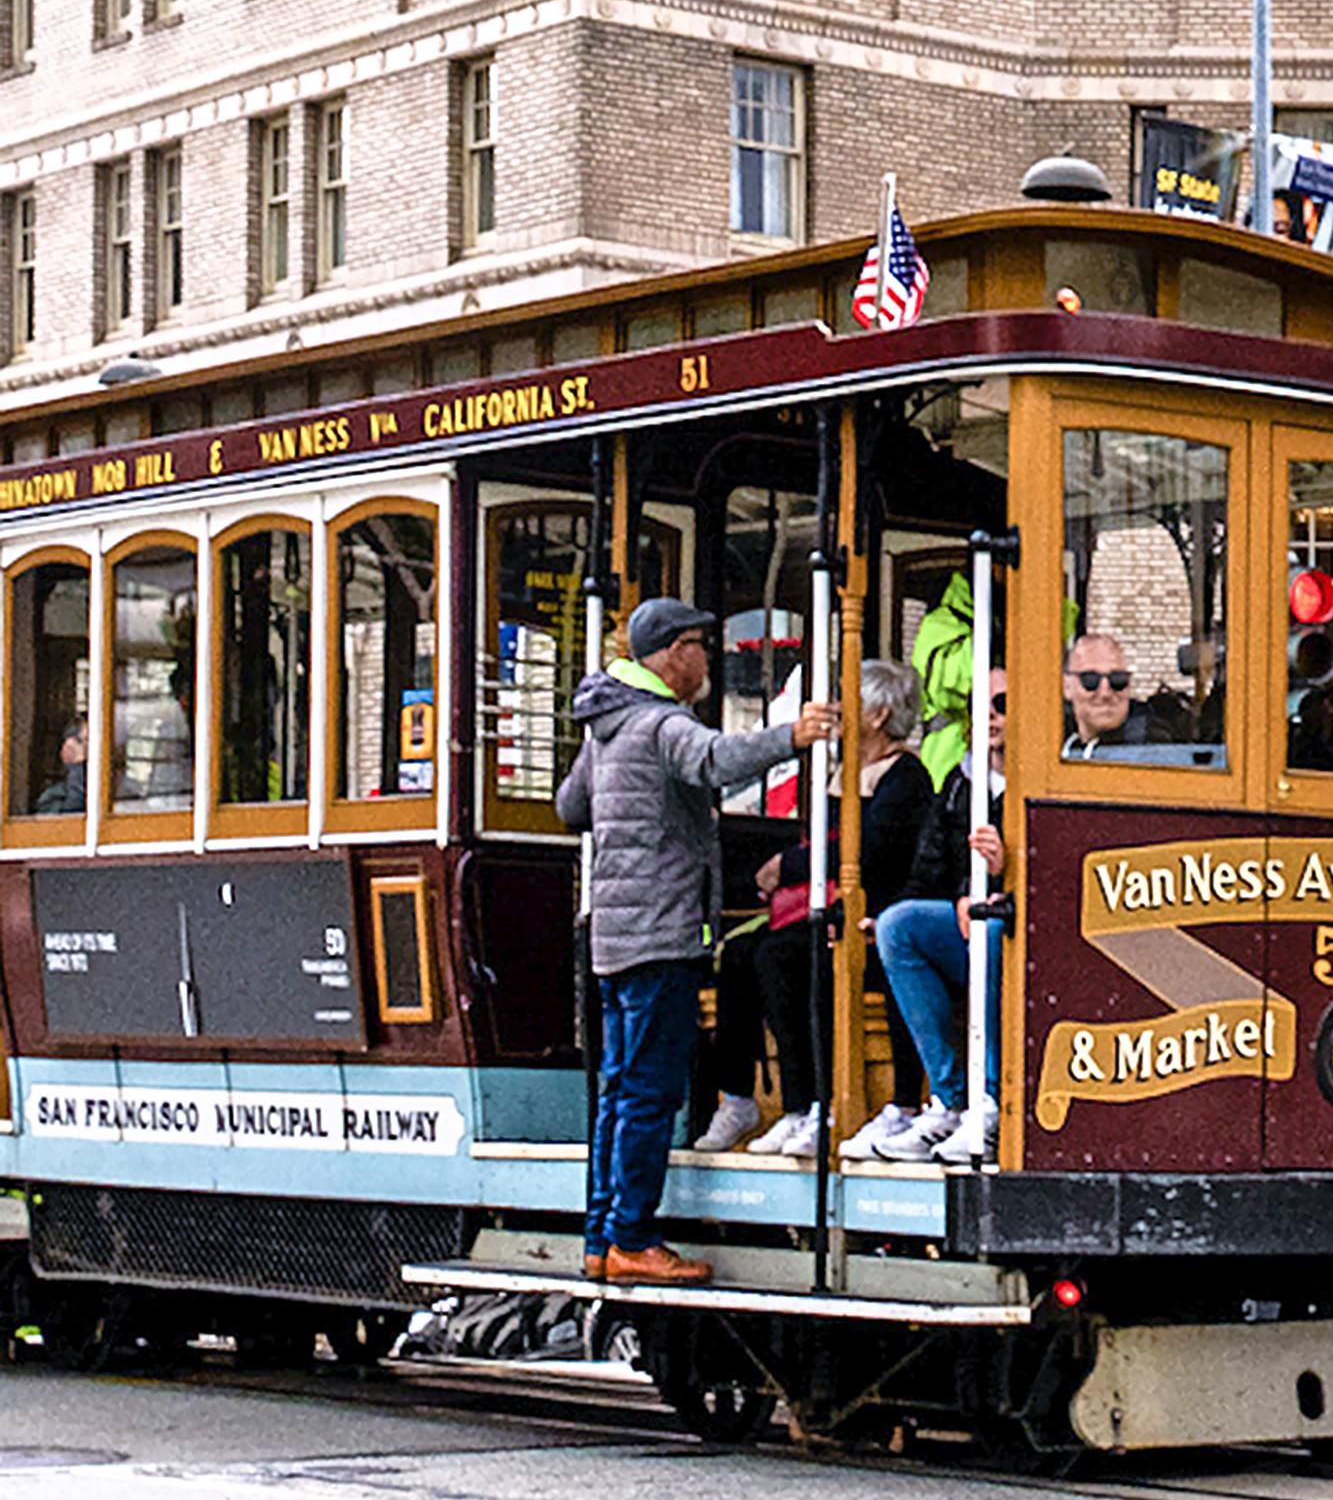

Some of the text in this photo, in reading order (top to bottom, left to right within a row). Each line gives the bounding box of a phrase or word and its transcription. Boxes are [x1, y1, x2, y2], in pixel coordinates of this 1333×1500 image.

[1157, 168, 1220, 203] SF State
[681, 355, 709, 392] 51
[93, 460, 126, 494] NOB
[136, 452, 175, 487] HILL
[210, 439, 222, 474] &
[424, 386, 554, 437] CALIFORNIA
[1096, 861, 1176, 912] Van
[1181, 853, 1286, 903] Ness
[1070, 1010, 1276, 1082] & Market
[38, 1096, 77, 1125] SAN
[85, 1099, 199, 1132] FRANCISCO
[342, 1107, 439, 1142] RAILWAY
